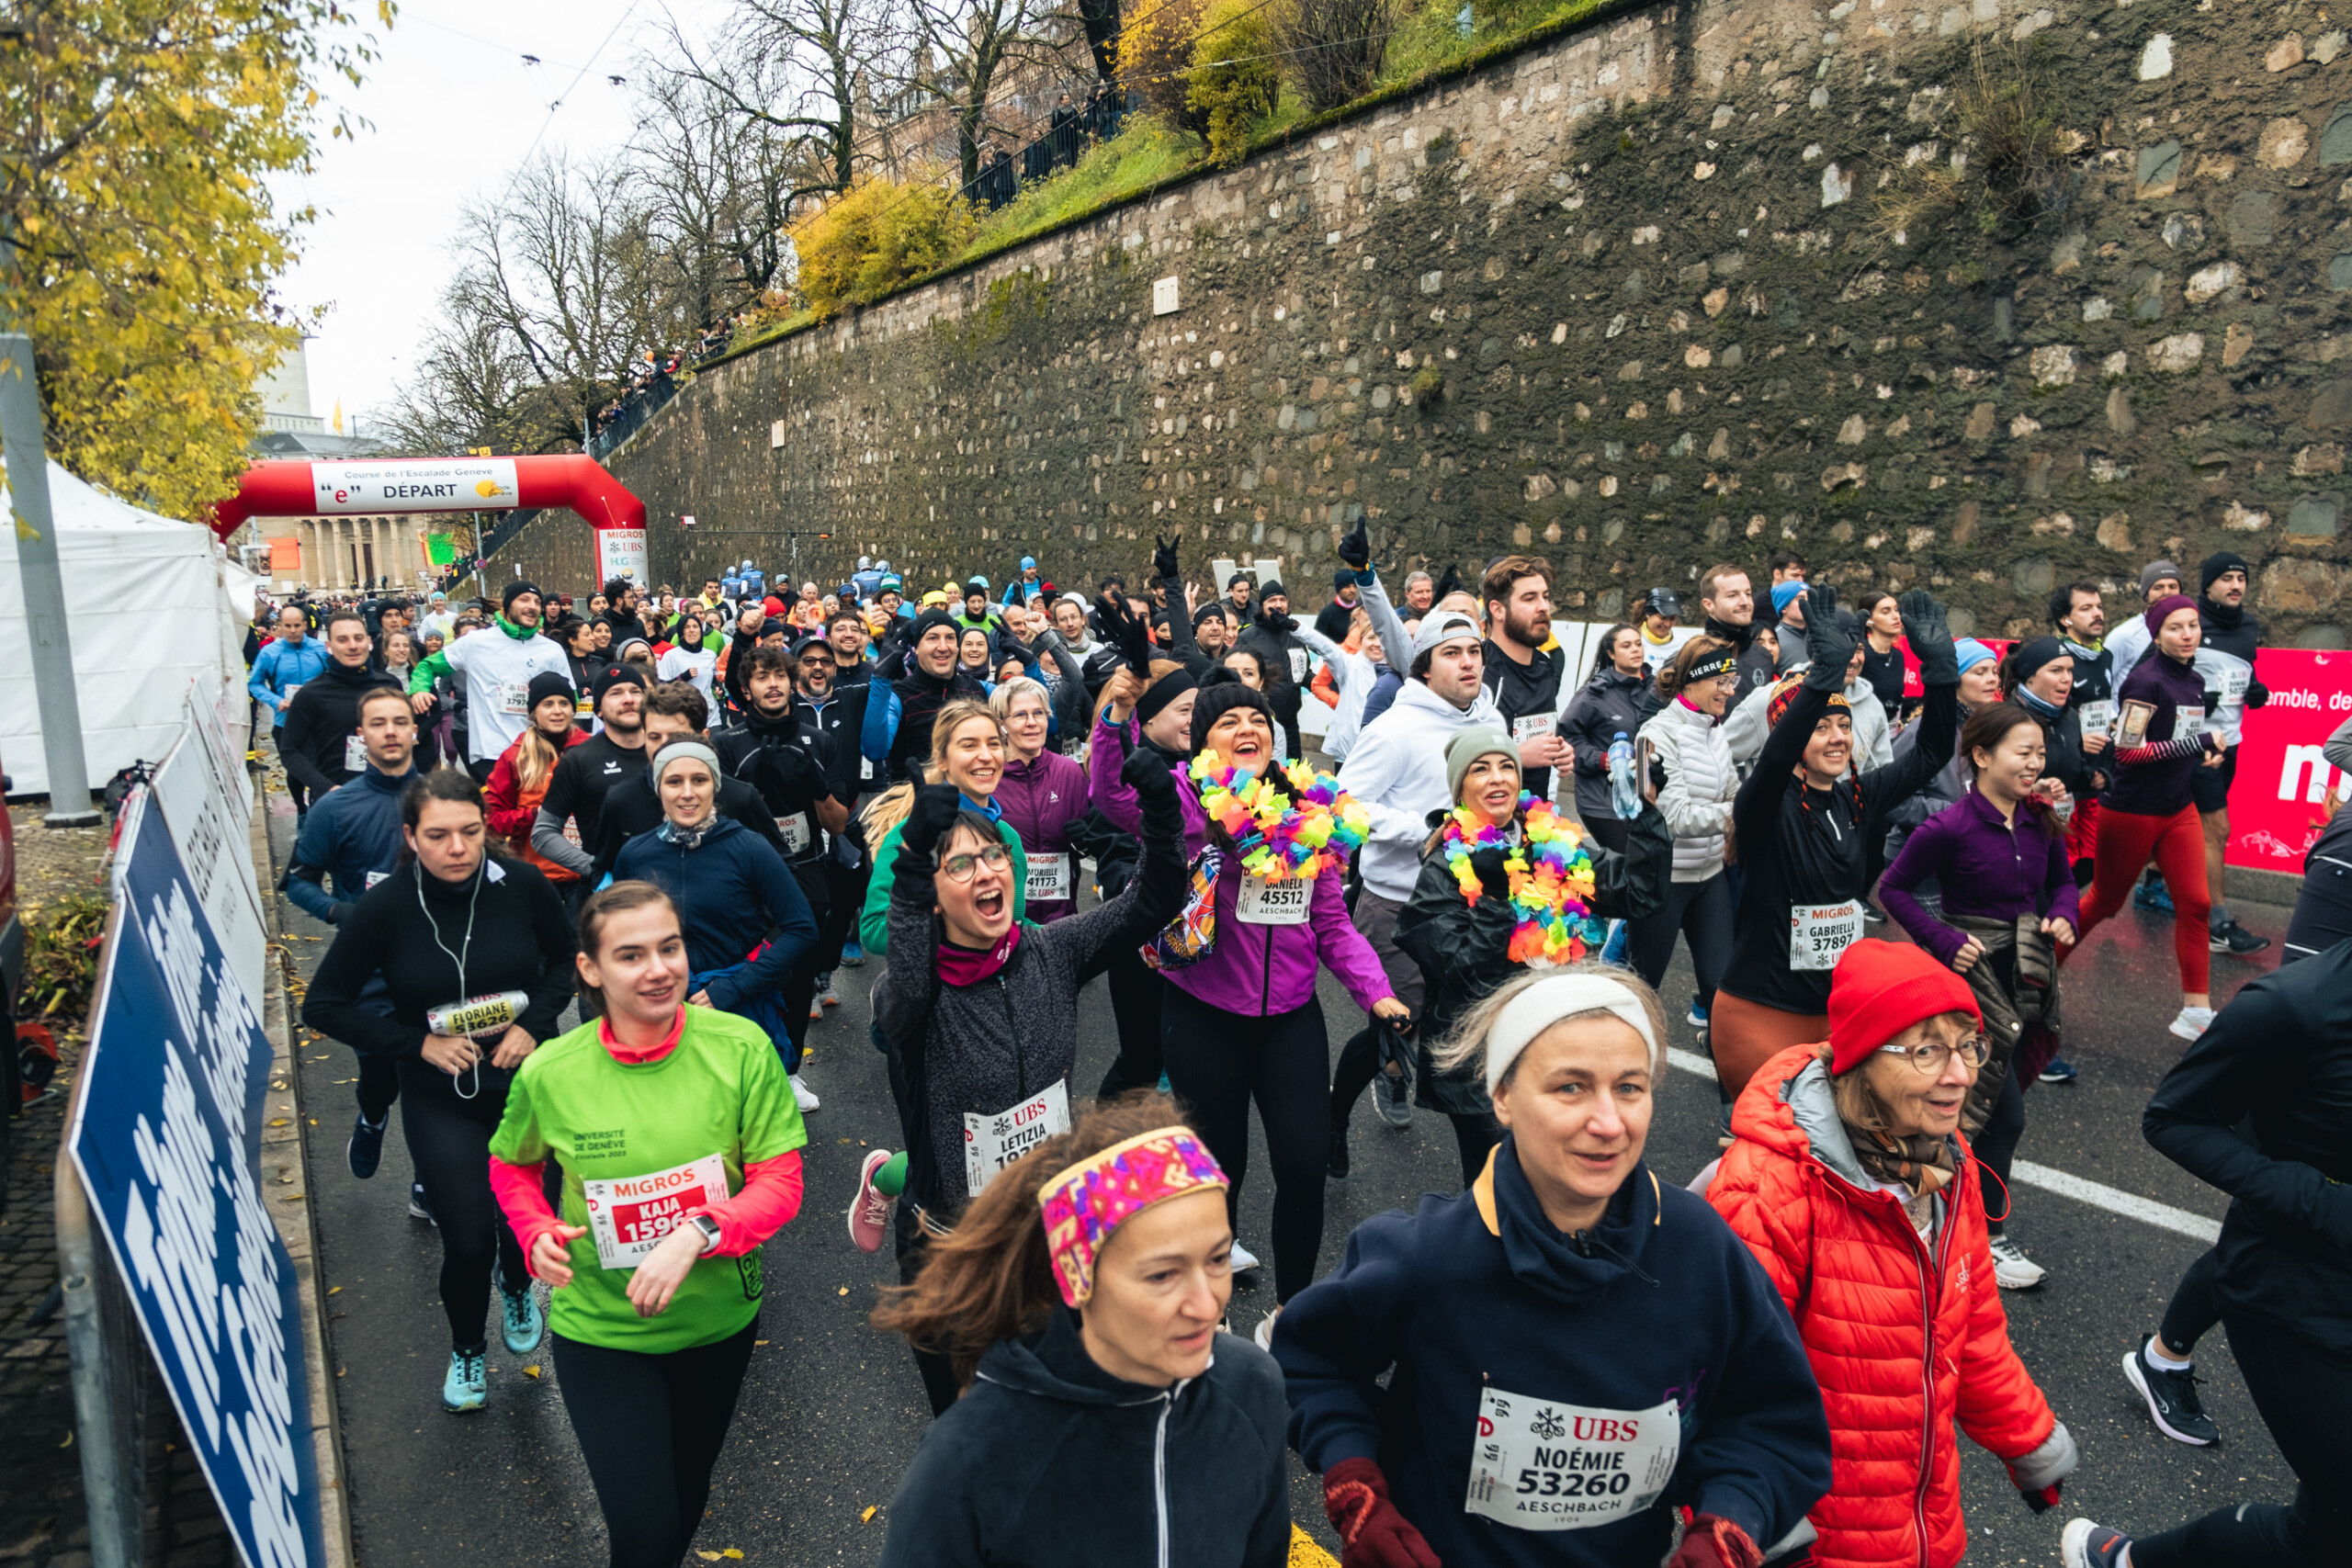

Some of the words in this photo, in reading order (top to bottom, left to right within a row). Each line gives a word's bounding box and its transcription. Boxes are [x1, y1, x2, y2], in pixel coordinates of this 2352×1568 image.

[400, 469, 451, 478] l'Escalade
[455, 468, 493, 477] Genève
[383, 482, 458, 499] DÉPART
[606, 531, 644, 539] MIGROS
[623, 542, 643, 552] UBS
[609, 557, 629, 566] HUG
[1689, 660, 1723, 678] SIERRE
[1532, 716, 1548, 728] UBS
[1027, 855, 1059, 864] MIGROS
[1027, 867, 1058, 877] MURIELLE
[1027, 877, 1057, 887] 41173
[1038, 888, 1056, 897] UBS
[1260, 890, 1304, 905] 45512
[1812, 905, 1854, 919] MIGROS
[1809, 921, 1855, 938] GABRIELLA
[1812, 933, 1854, 952] 37897
[453, 1002, 507, 1025] FLORIANE
[1013, 1098, 1046, 1126] UBS
[573, 1128, 626, 1141] UNIVERSITÉ
[1001, 1122, 1046, 1153] LETIZIA
[574, 1143, 584, 1152] DE
[588, 1140, 626, 1150] GENÈVE
[614, 1168, 695, 1198] MIGROS
[639, 1197, 681, 1220] KAJA
[624, 1206, 698, 1242] 1596
[1573, 1416, 1639, 1442] UBS
[1533, 1447, 1625, 1470] NOÉMIE
[1515, 1469, 1631, 1496] 53260
[1516, 1499, 1622, 1514] AESCHBACH
